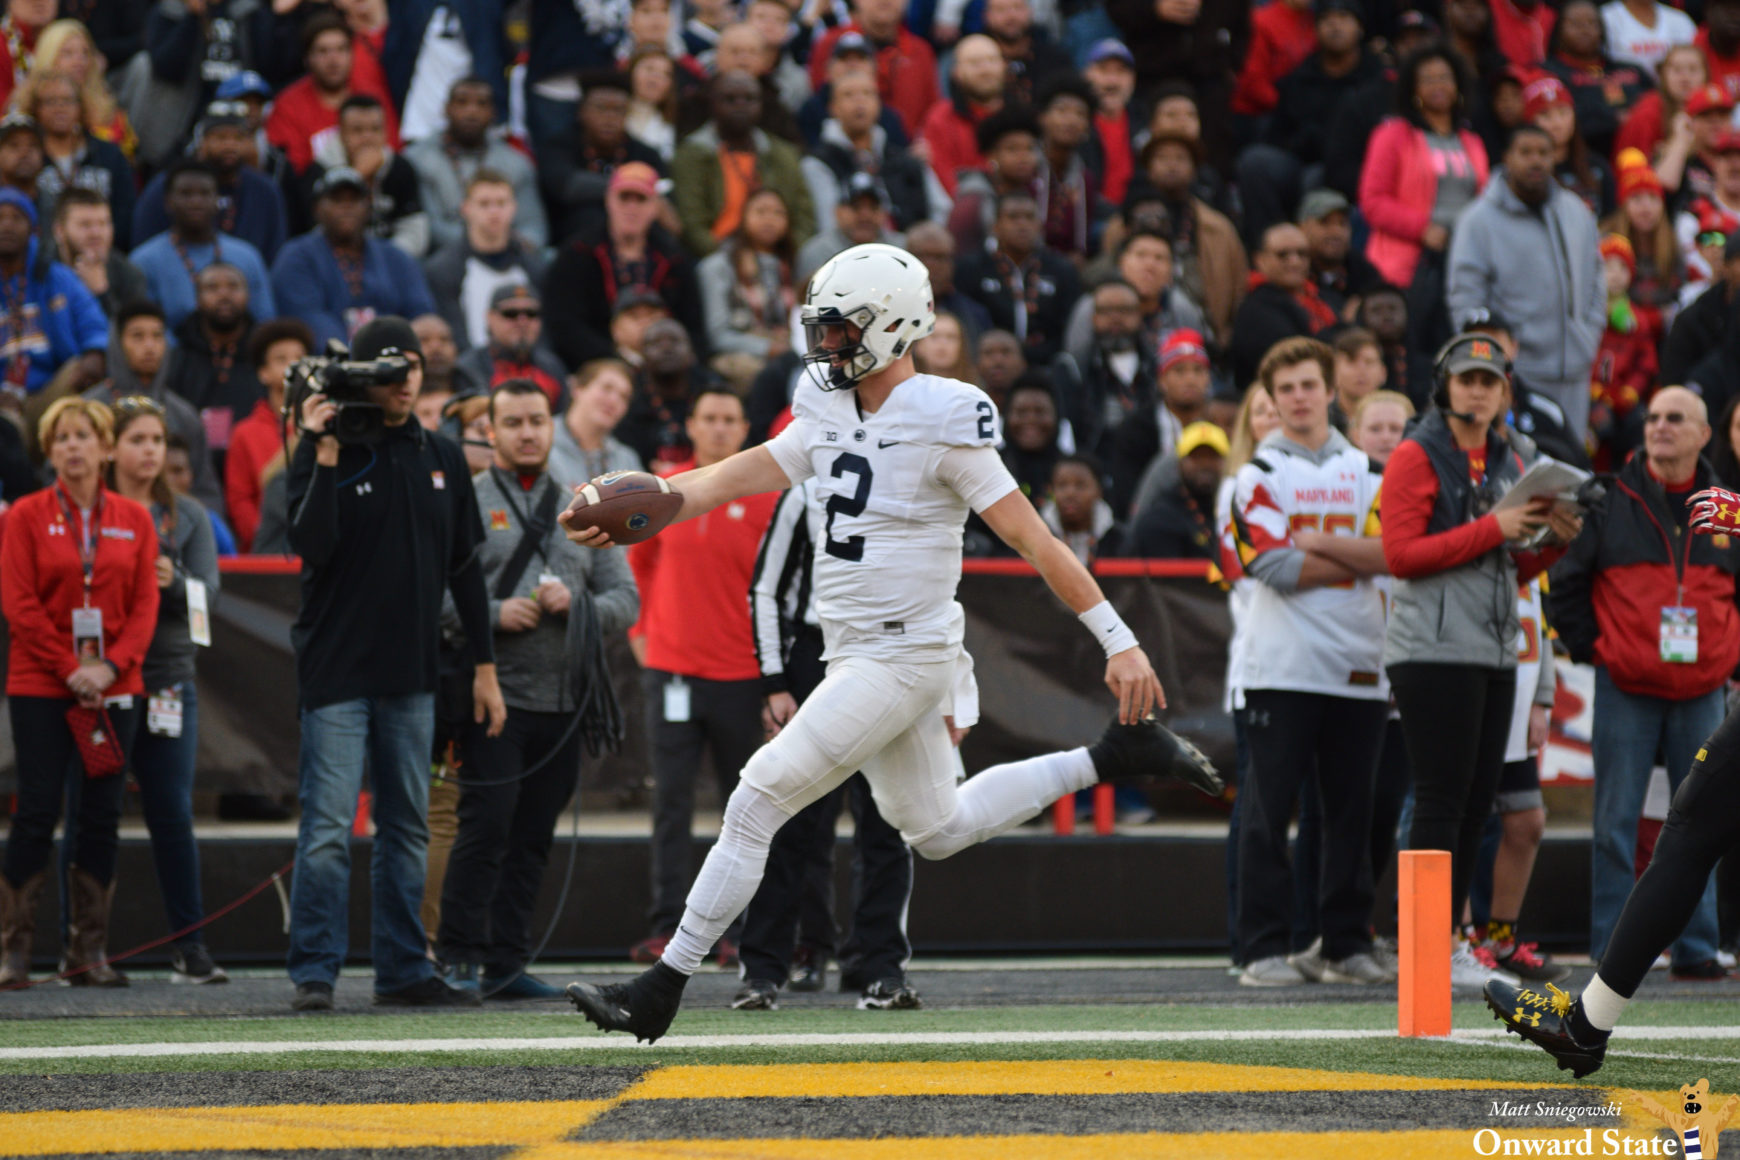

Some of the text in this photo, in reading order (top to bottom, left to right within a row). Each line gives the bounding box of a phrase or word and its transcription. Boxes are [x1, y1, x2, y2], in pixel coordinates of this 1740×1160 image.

[1471, 340, 1492, 360] M
[976, 401, 995, 440] 2
[825, 452, 873, 562] 2
